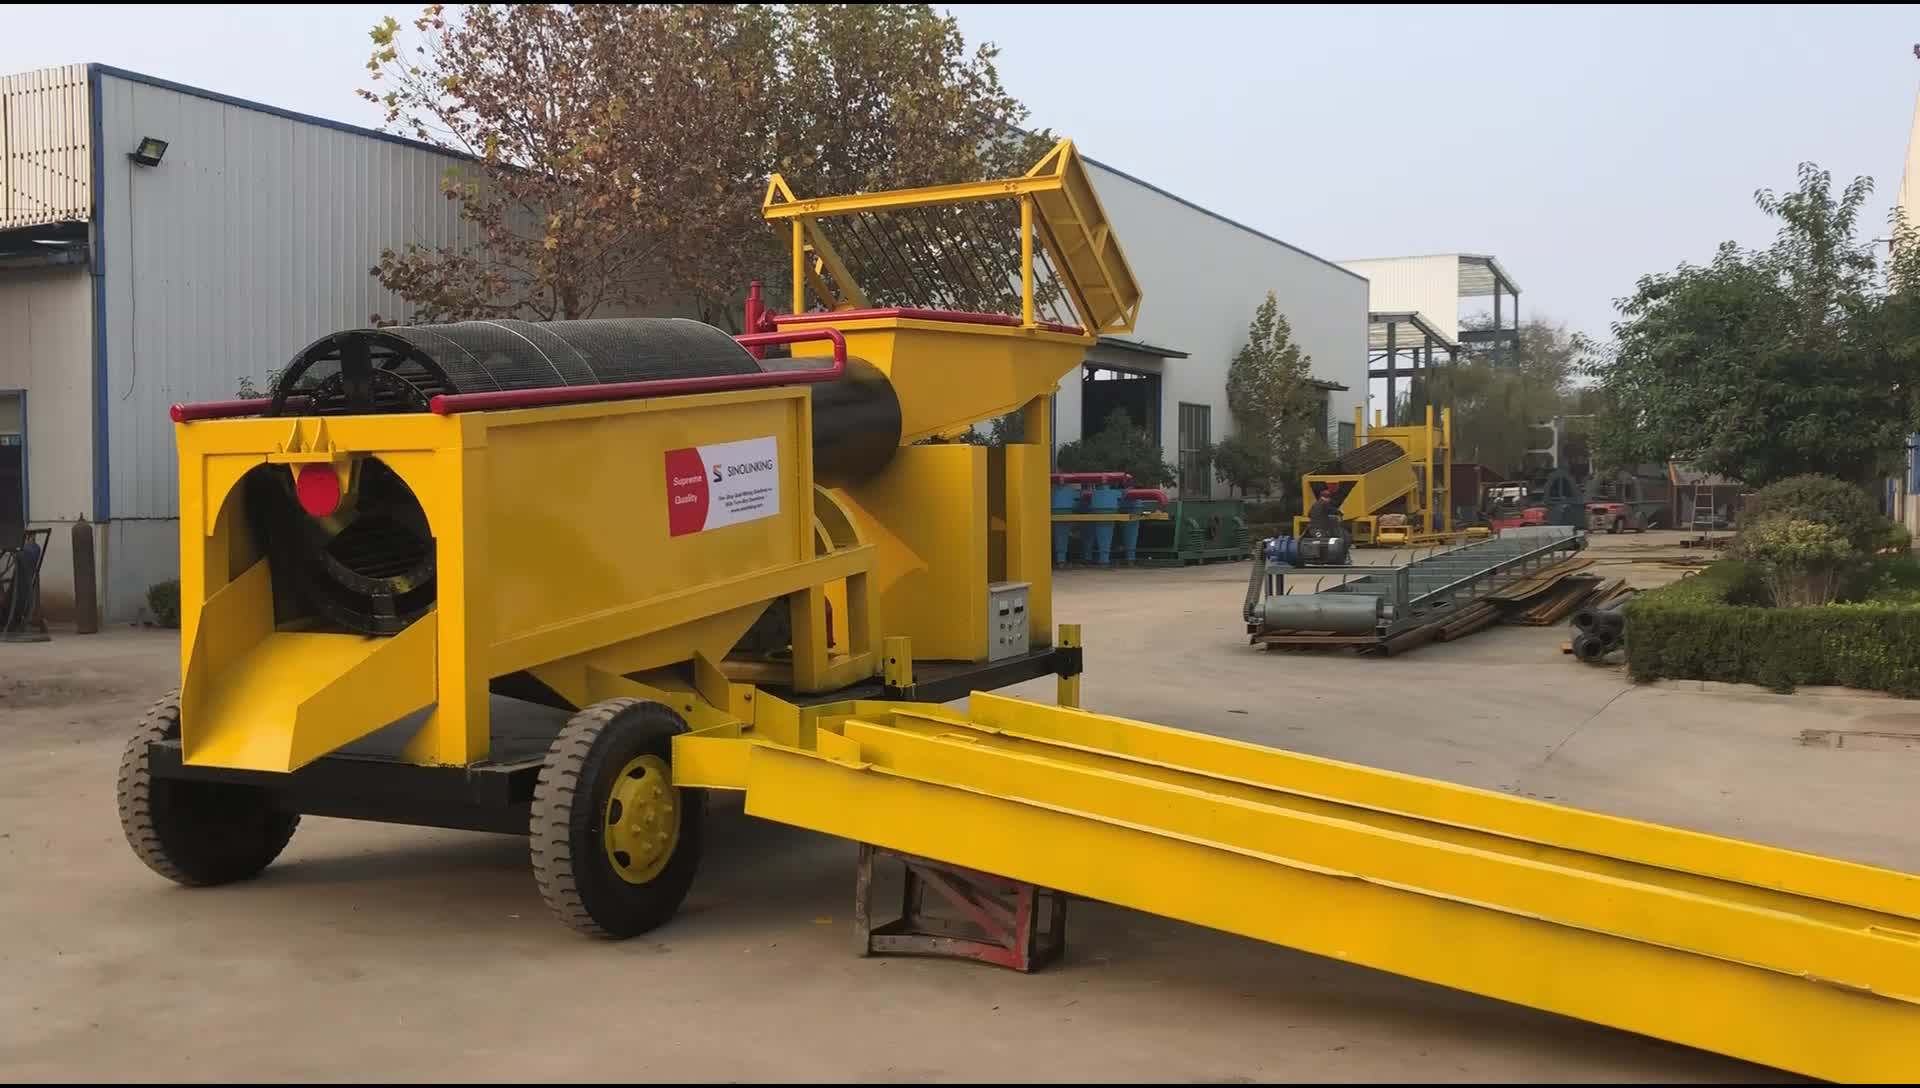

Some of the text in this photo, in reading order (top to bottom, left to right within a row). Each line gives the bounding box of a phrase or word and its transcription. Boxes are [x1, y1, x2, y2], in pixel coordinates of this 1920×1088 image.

[727, 460, 773, 477] SINOLINKING
[673, 475, 702, 487] Supreme
[674, 494, 698, 505] Quality
